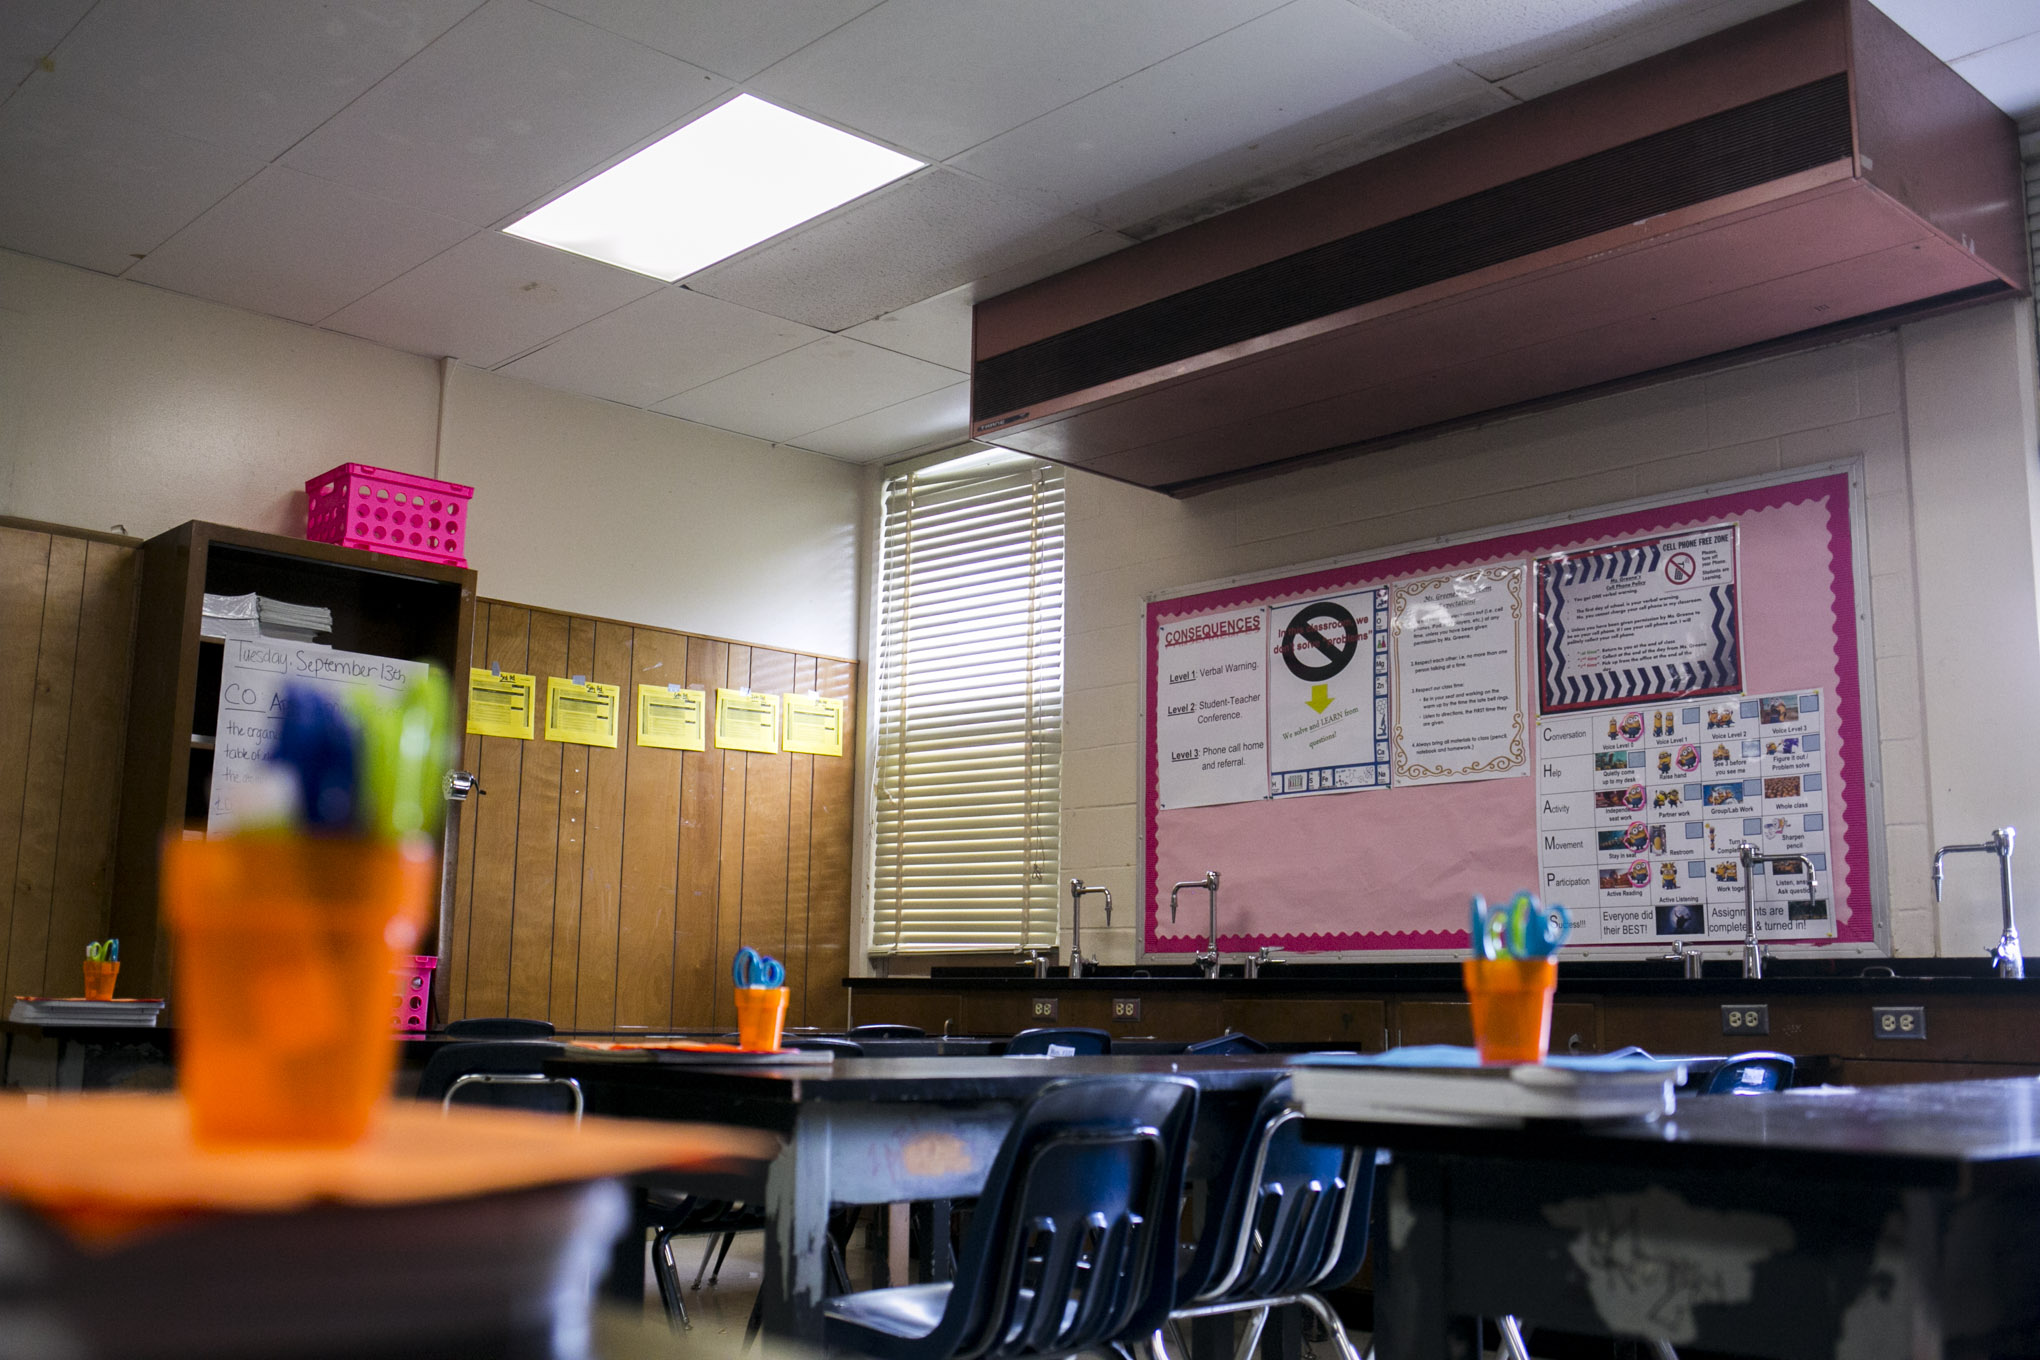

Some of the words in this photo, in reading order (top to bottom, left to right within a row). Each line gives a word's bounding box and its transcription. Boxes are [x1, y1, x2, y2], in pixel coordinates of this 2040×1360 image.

[1663, 543, 1677, 551] CELL
[1678, 539, 1697, 549] PHONE
[1699, 537, 1712, 545] FREE
[1714, 534, 1728, 543] ZONE
[1165, 616, 1260, 646] CONSEQUENCES
[1278, 629, 1286, 638] In
[1356, 616, 1368, 624] we
[296, 650, 377, 679] September
[381, 662, 406, 683] 13th
[1170, 671, 1189, 683] Level
[1200, 665, 1223, 677] Verbal
[1225, 661, 1258, 672] Warning.
[1168, 704, 1188, 716] Level
[1199, 694, 1260, 710] Student-Teacher
[1198, 712, 1242, 724] Conference.
[1282, 731, 1293, 740] We
[1294, 727, 1308, 736] solve
[1309, 720, 1320, 730] and
[1320, 711, 1343, 726] LEARN
[1344, 707, 1359, 716] from
[226, 720, 245, 736] the
[1543, 728, 1586, 741] Conversation
[1309, 731, 1337, 749] questions!
[224, 744, 250, 760] table
[251, 748, 260, 760] of
[1171, 750, 1192, 762] Level
[1203, 747, 1226, 756] Phone
[1228, 743, 1241, 753] call
[1243, 742, 1264, 751] home
[1202, 761, 1215, 770] and
[1217, 757, 1245, 768] referral.
[1543, 764, 1561, 778] Help
[1543, 800, 1570, 814] Activity
[1545, 836, 1583, 850] Movement
[1546, 873, 1590, 887] Participation
[1603, 911, 1639, 922] Everyone
[1642, 910, 1653, 919] did
[1712, 907, 1766, 919] Assignmnts
[1604, 926, 1620, 935] their
[1623, 925, 1647, 934] BEST!
[1709, 922, 1748, 933] complete
[1755, 921, 1762, 931] &
[1765, 920, 1793, 930] turned
[1796, 920, 1806, 929] in!
